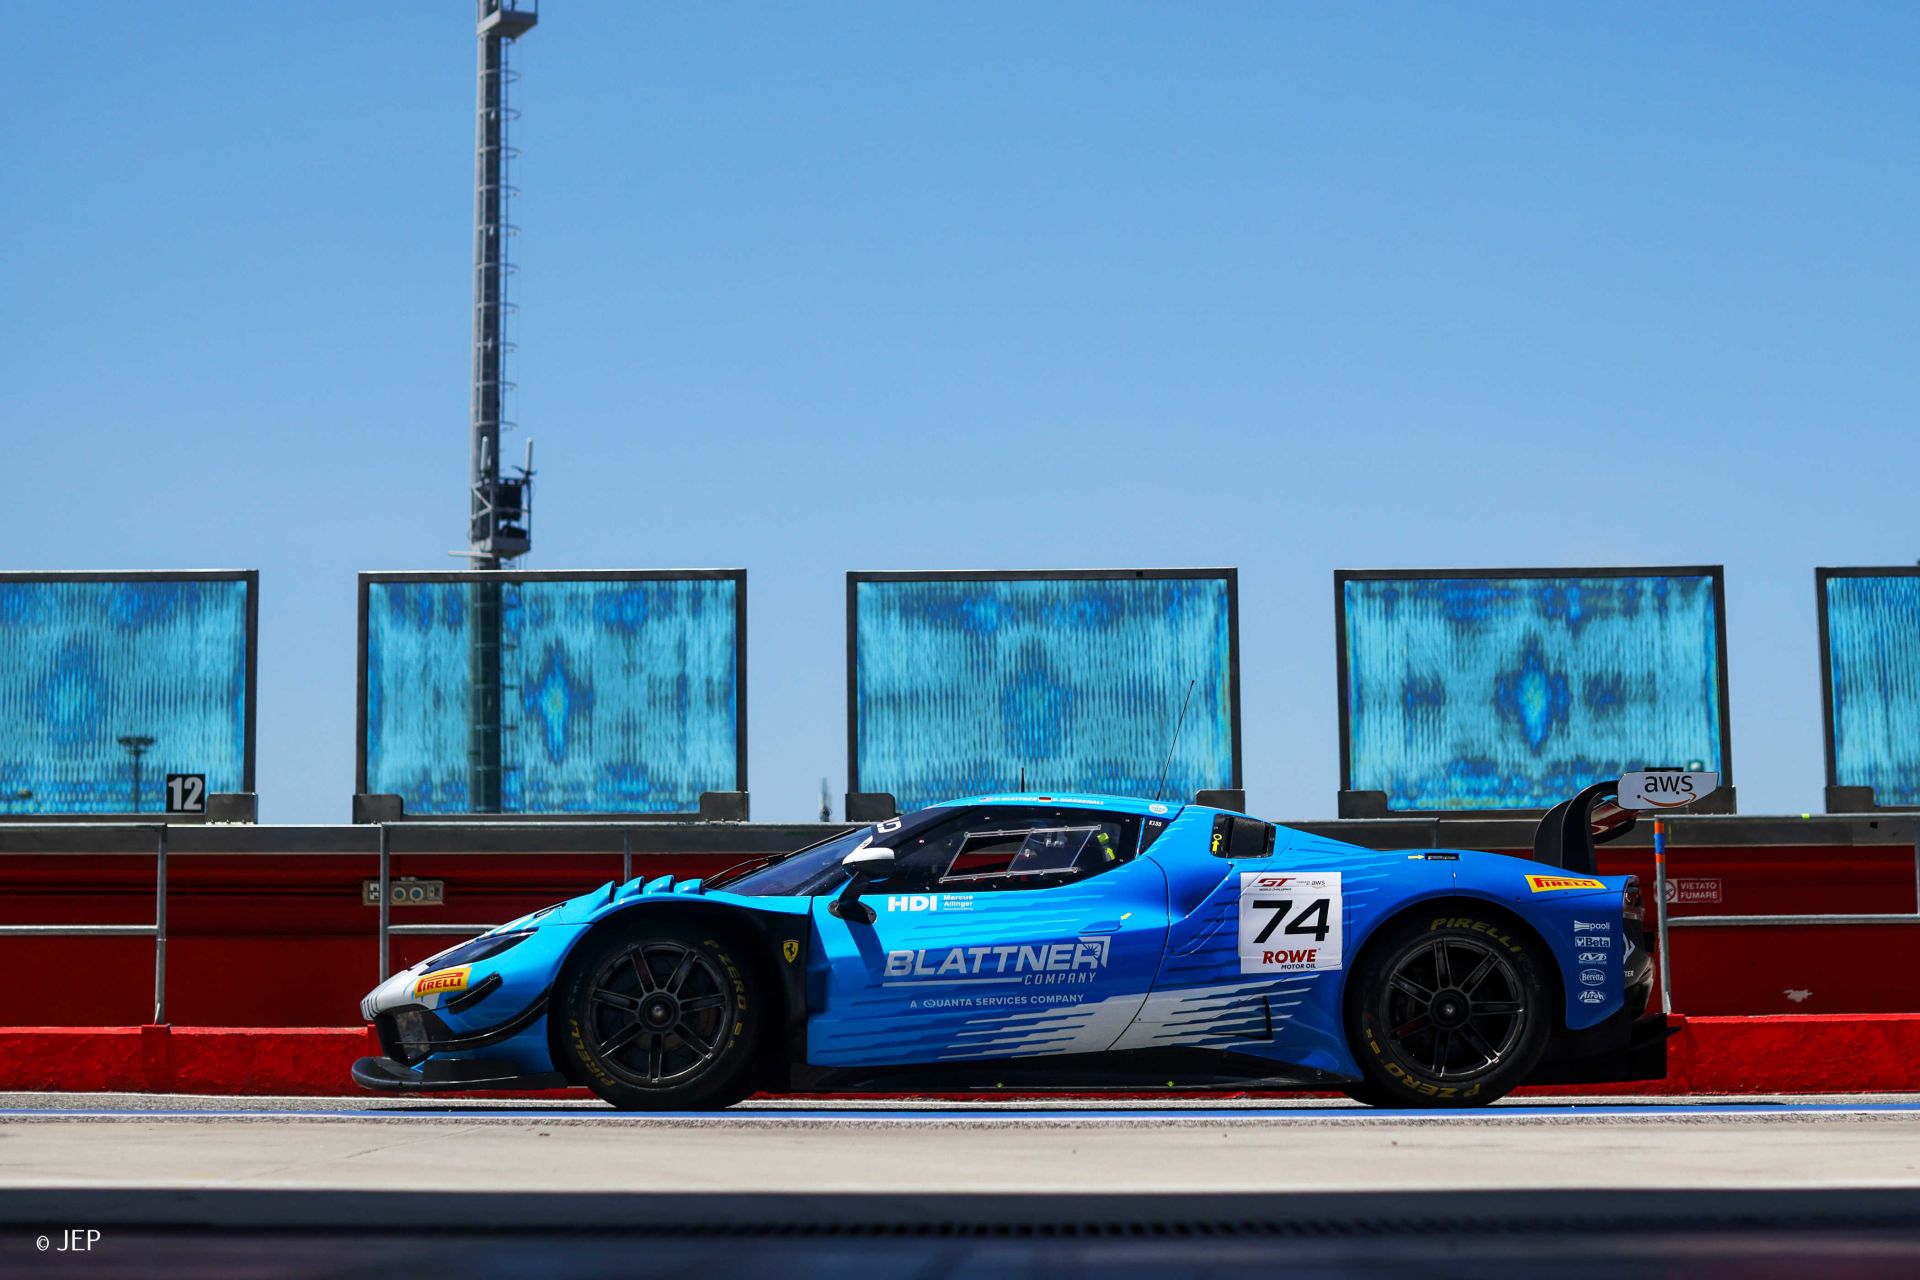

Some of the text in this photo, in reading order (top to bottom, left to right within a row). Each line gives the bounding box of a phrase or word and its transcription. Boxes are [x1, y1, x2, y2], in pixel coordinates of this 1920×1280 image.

[1645, 775, 1694, 793] aws
[168, 776, 203, 810] 12
[1533, 877, 1598, 889] PIRELLI
[1680, 881, 1718, 890] VIETATO
[888, 895, 938, 912] HDI
[1680, 890, 1718, 900] FUMARE
[1252, 898, 1331, 944] 74
[1430, 917, 1523, 954] PIRELLI
[1586, 938, 1609, 946] Beta
[884, 940, 1106, 977] BLATTNER
[1262, 949, 1318, 964] ROWE
[417, 972, 465, 993] PIRELLI
[1025, 972, 1097, 985] COMPANY
[910, 994, 1085, 1009] A QUANTA SERVICES COMPANY
[569, 1018, 616, 1087] PIRELLI
[1384, 1061, 1459, 1099] ZERO
